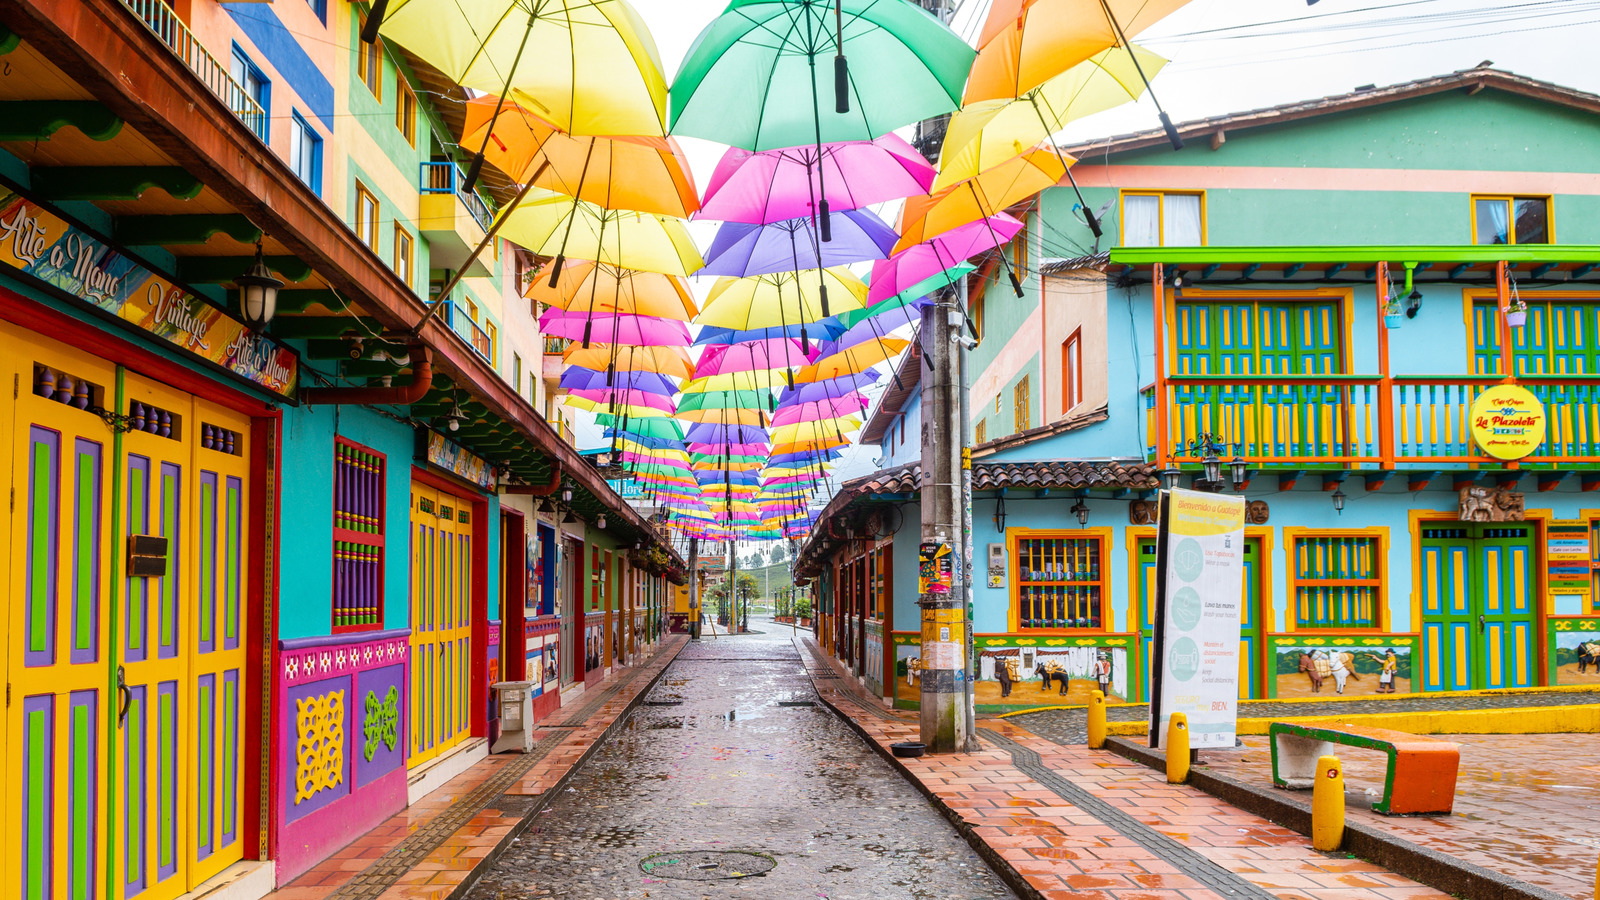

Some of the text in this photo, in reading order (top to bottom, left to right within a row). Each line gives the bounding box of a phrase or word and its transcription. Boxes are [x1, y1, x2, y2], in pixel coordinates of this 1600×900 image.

[0, 204, 119, 303] Arte a Mano
[147, 281, 210, 351] Vintage
[226, 329, 291, 389] Arte a Mano
[1476, 416, 1541, 429] La Plazoleta
[1178, 500, 1211, 512] Bienvenido
[1178, 513, 1206, 524] Welcome
[1214, 677, 1234, 685] distancing
[1175, 695, 1200, 704] SEGURO
